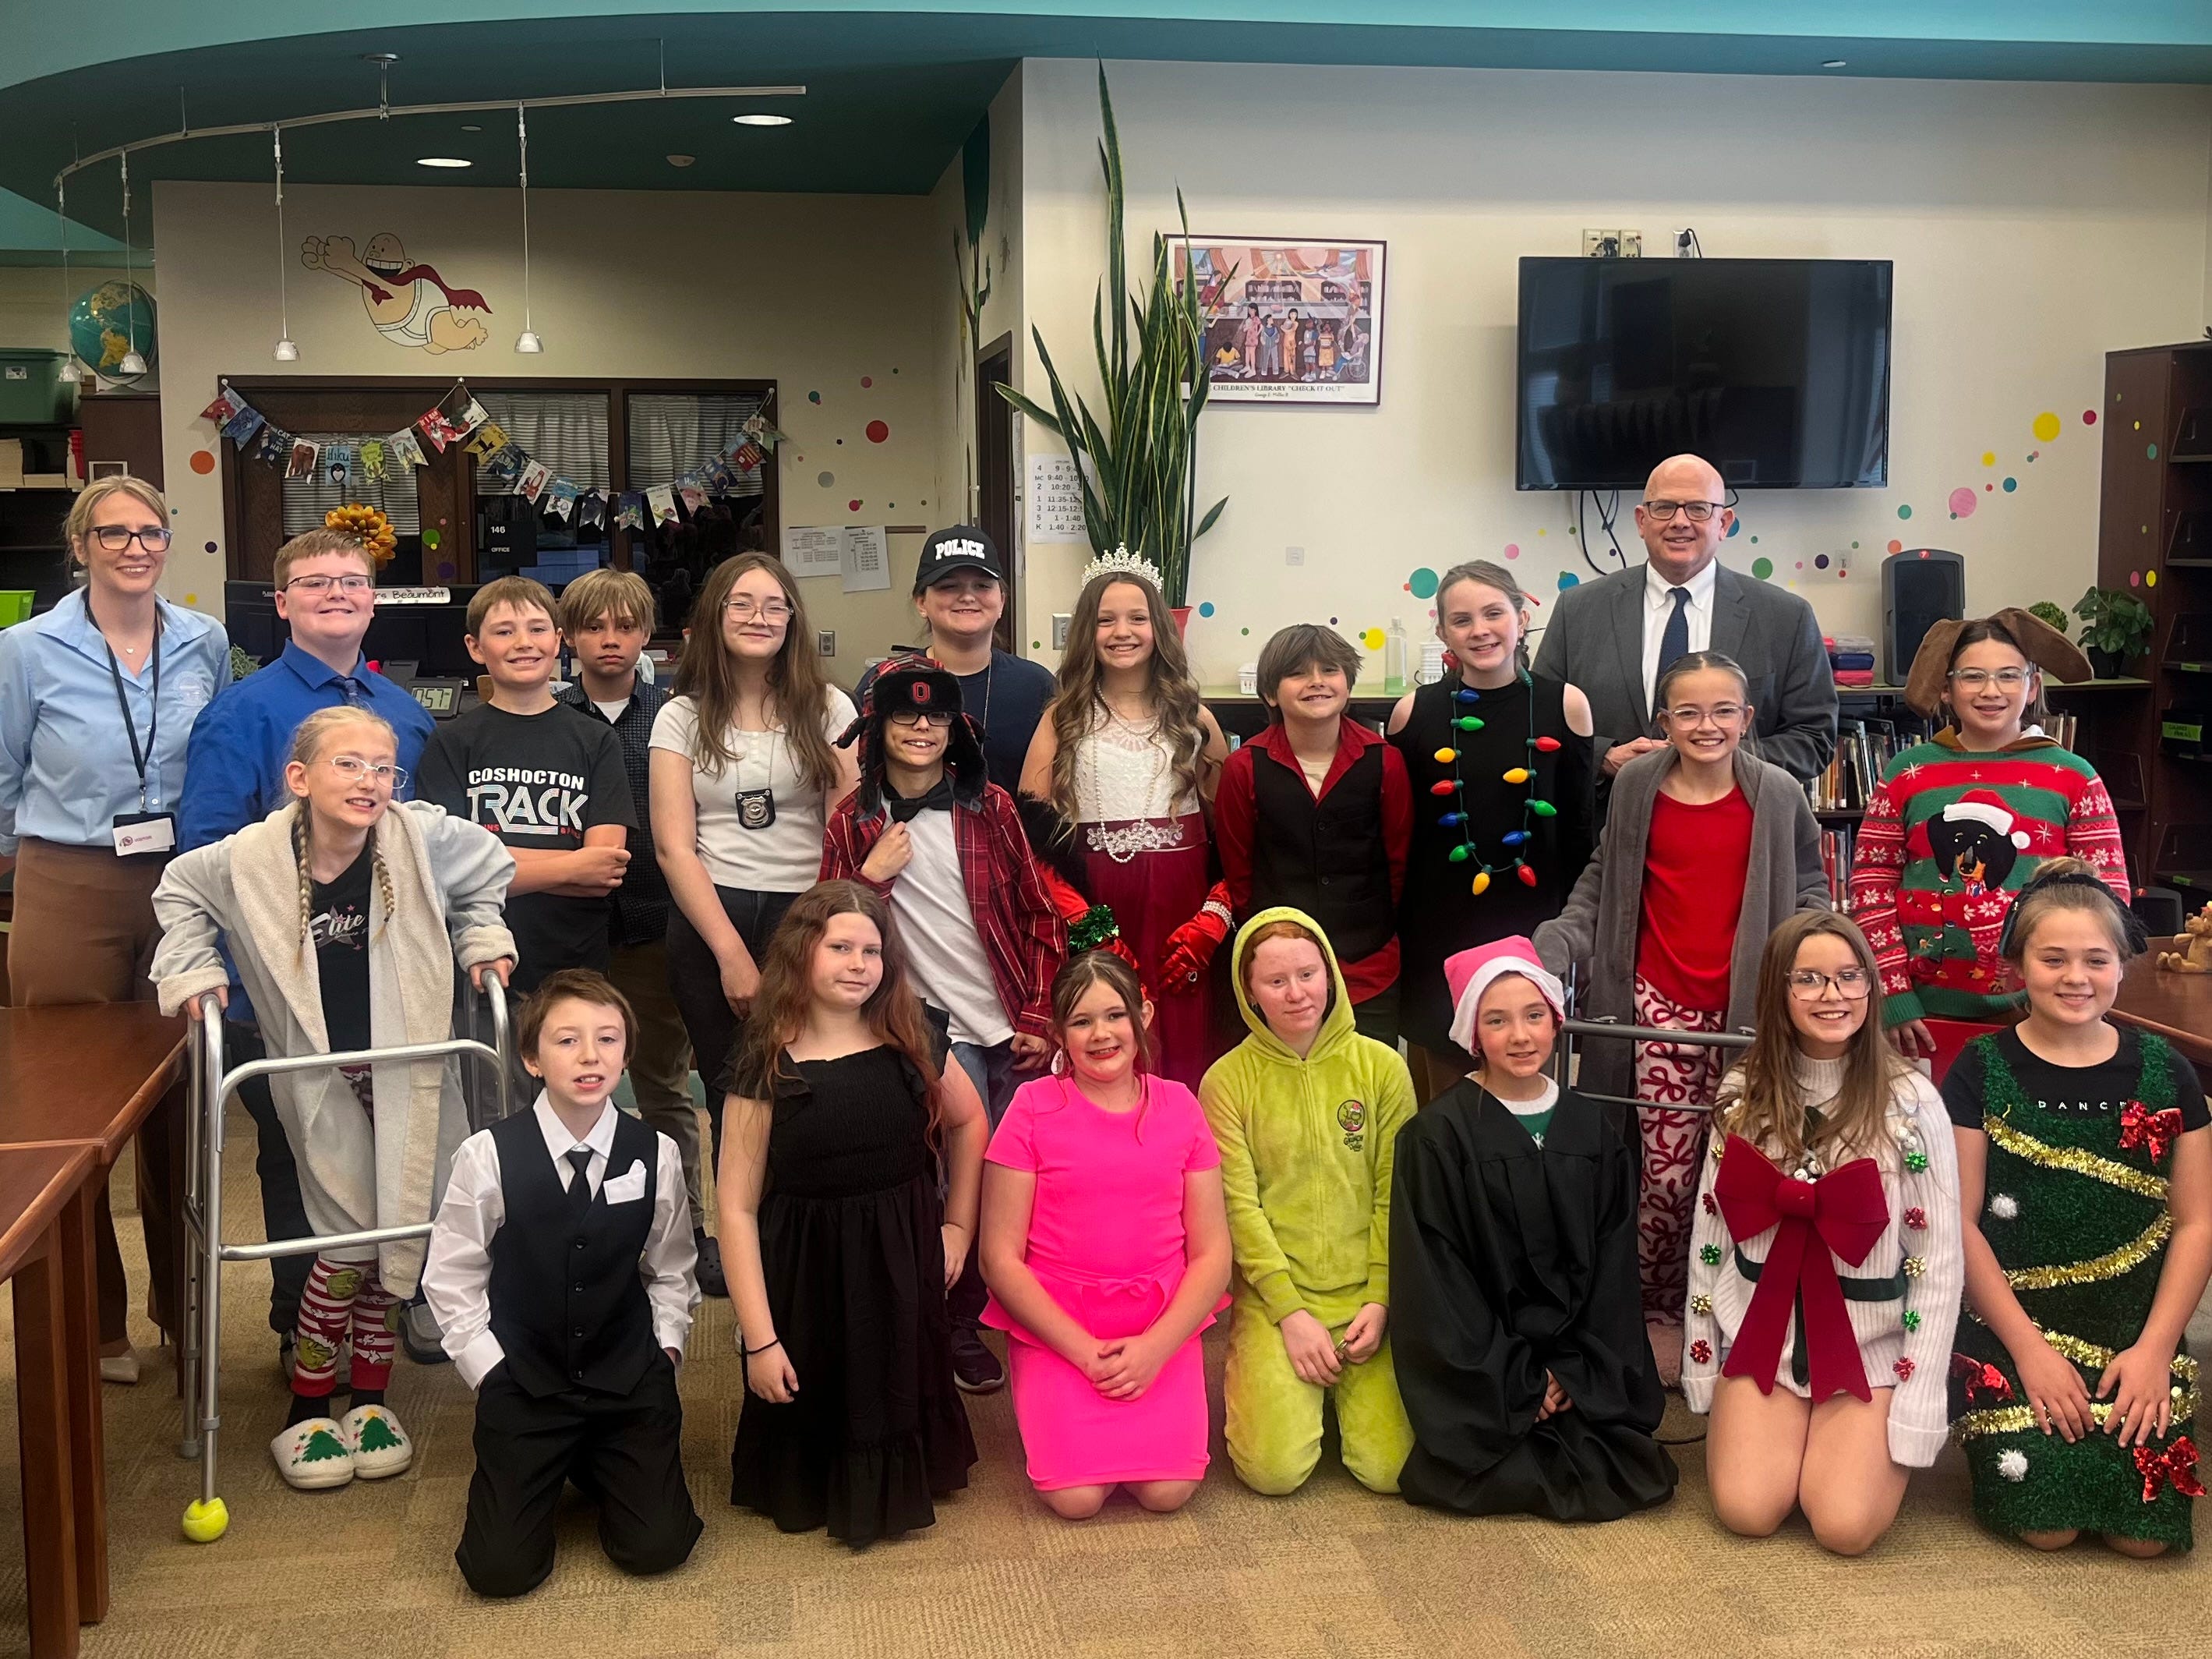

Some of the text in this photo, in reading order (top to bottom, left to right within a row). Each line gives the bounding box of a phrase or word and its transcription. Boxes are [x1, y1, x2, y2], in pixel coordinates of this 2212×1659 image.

[277, 430, 291, 440] CAT
[270, 444, 283, 454] HAT
[935, 539, 985, 561] POLICE
[392, 589, 445, 600] Beaumont
[468, 768, 585, 791] COSHOCTON
[467, 784, 588, 835] TRACK
[310, 912, 366, 943] Elite
